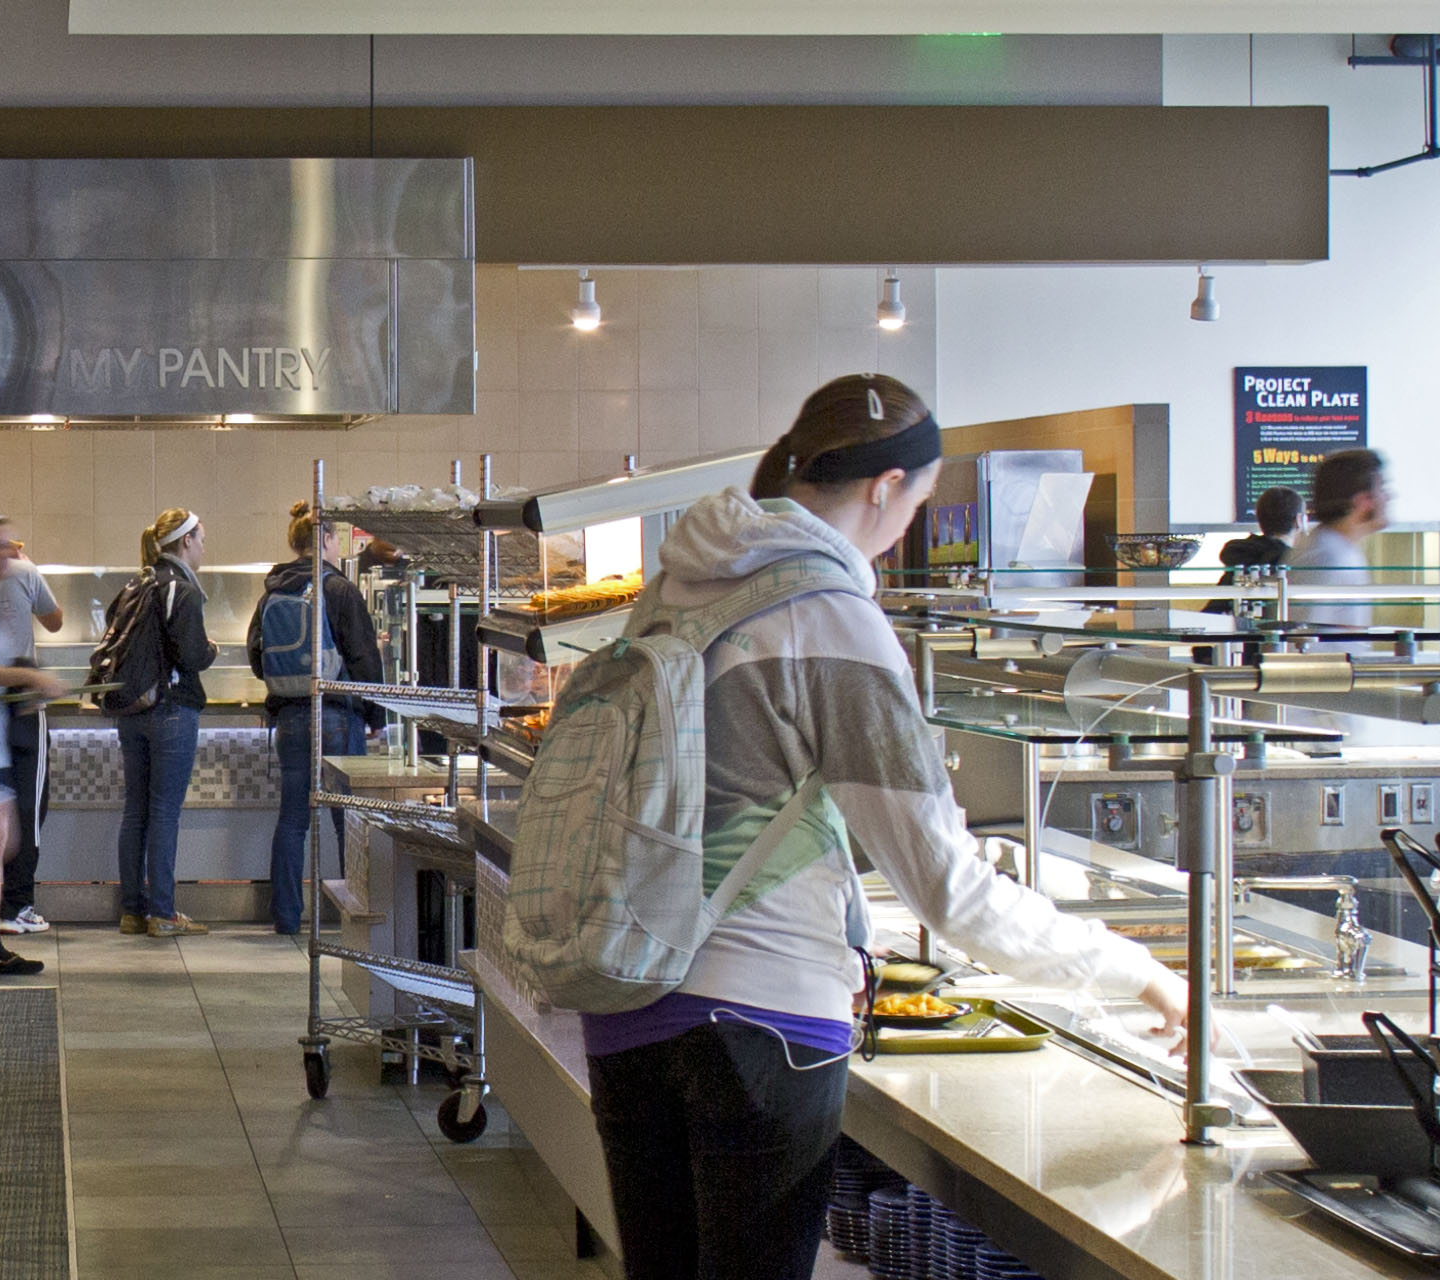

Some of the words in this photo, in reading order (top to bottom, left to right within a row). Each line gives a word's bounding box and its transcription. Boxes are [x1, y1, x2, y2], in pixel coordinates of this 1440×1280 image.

[70, 348, 141, 389] MY
[158, 347, 331, 390] PANTRY
[1244, 375, 1311, 393] PROJECT
[1256, 391, 1307, 407] CLEAN
[1311, 390, 1359, 407] PLATE
[1253, 450, 1262, 464] 5
[1263, 448, 1300, 465] Ways
